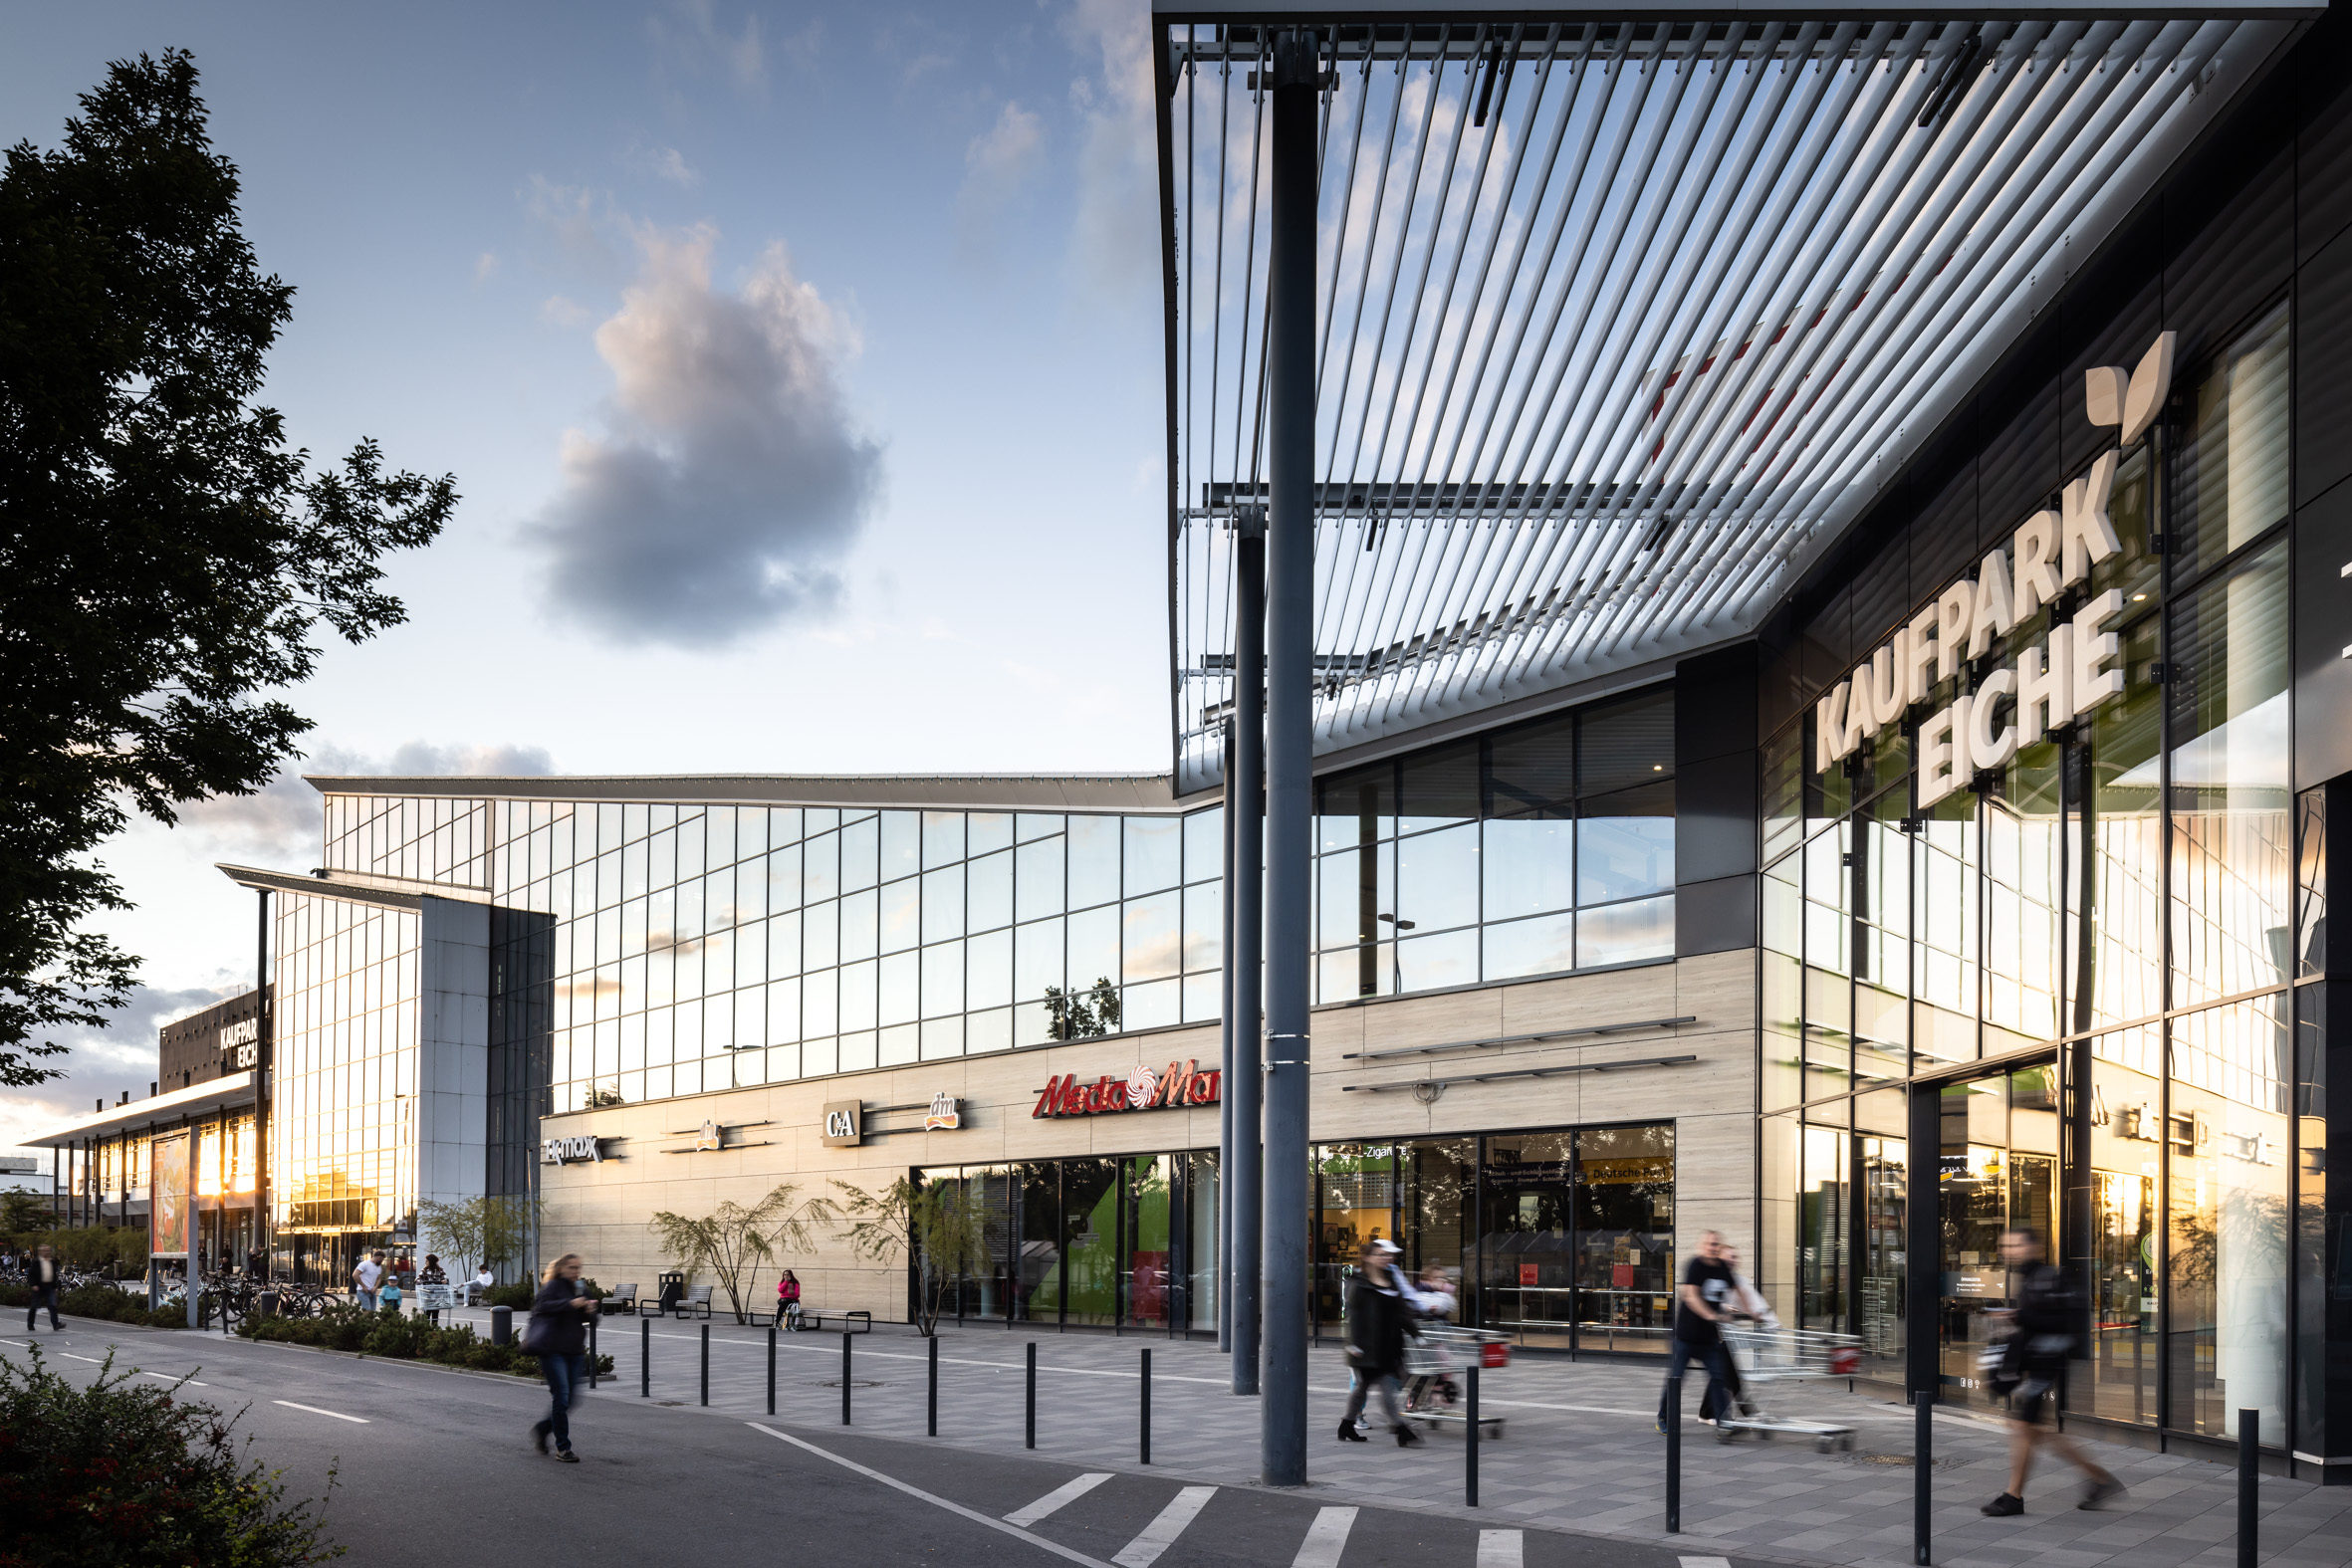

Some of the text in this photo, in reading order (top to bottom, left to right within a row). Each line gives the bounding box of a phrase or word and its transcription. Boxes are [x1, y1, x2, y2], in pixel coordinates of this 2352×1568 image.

[1816, 449, 2122, 774] KAUFPARK
[1918, 588, 2125, 808] EICHE
[220, 1017, 257, 1050] KAUFPAR
[238, 1041, 257, 1067] EICH
[825, 1110, 855, 1138] C&A
[1593, 1168, 1640, 1179] Deutsche
